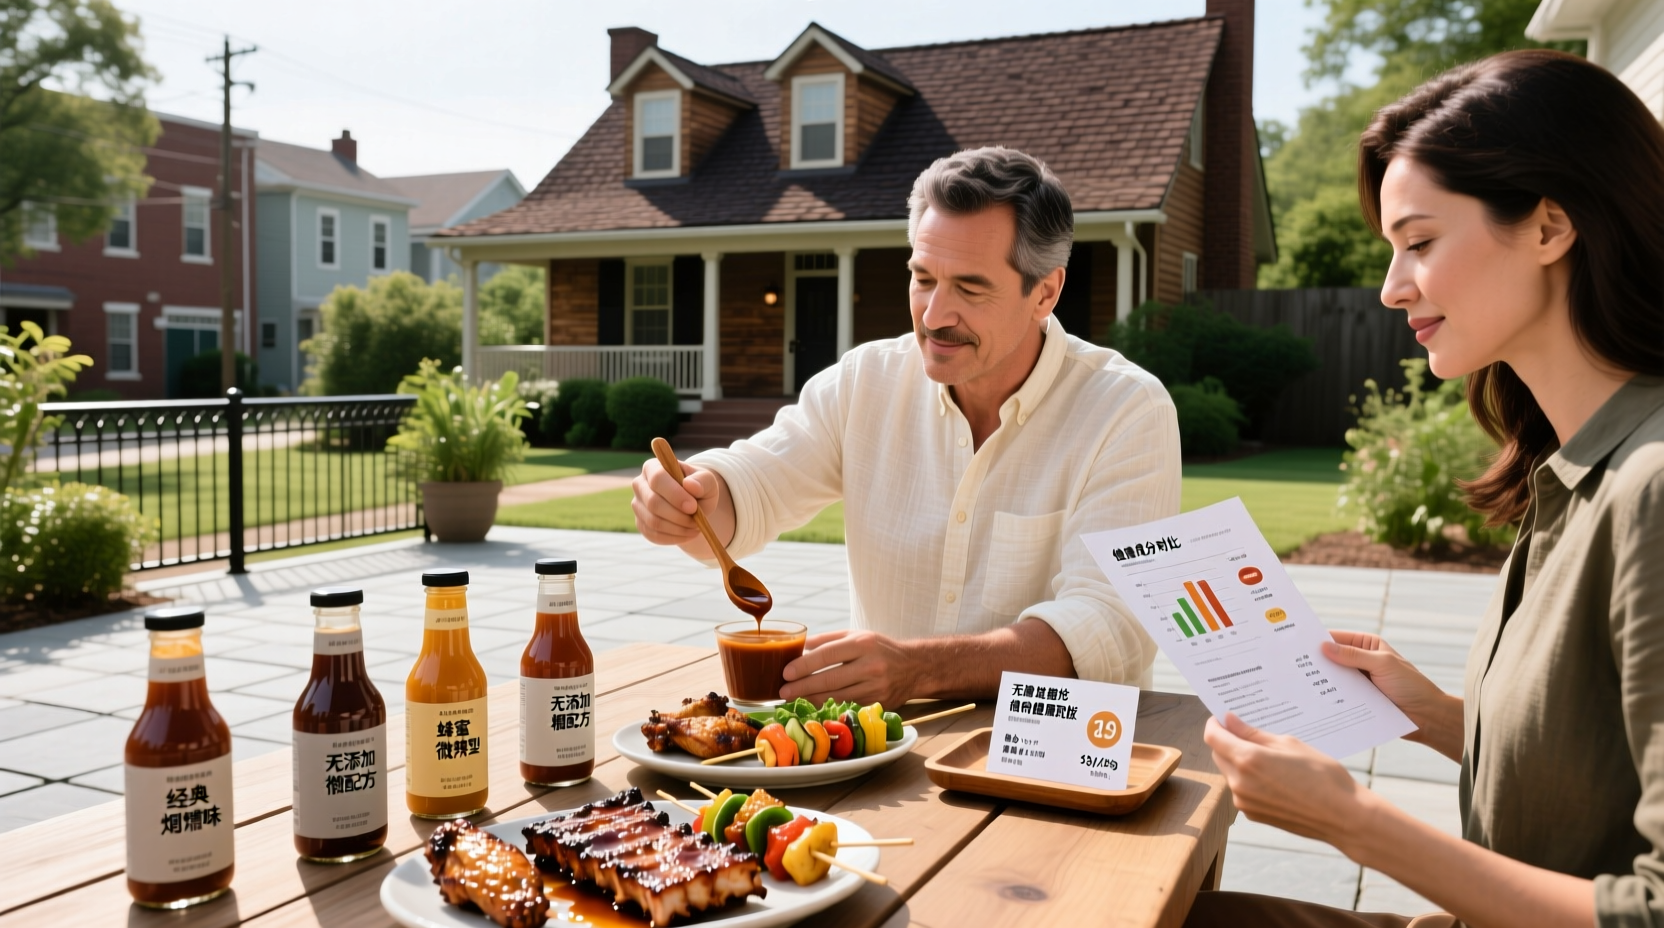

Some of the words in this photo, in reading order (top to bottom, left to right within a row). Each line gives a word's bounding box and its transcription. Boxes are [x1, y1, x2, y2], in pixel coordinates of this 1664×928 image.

[325, 749, 376, 773] 无添加
[166, 784, 209, 809] 经典
